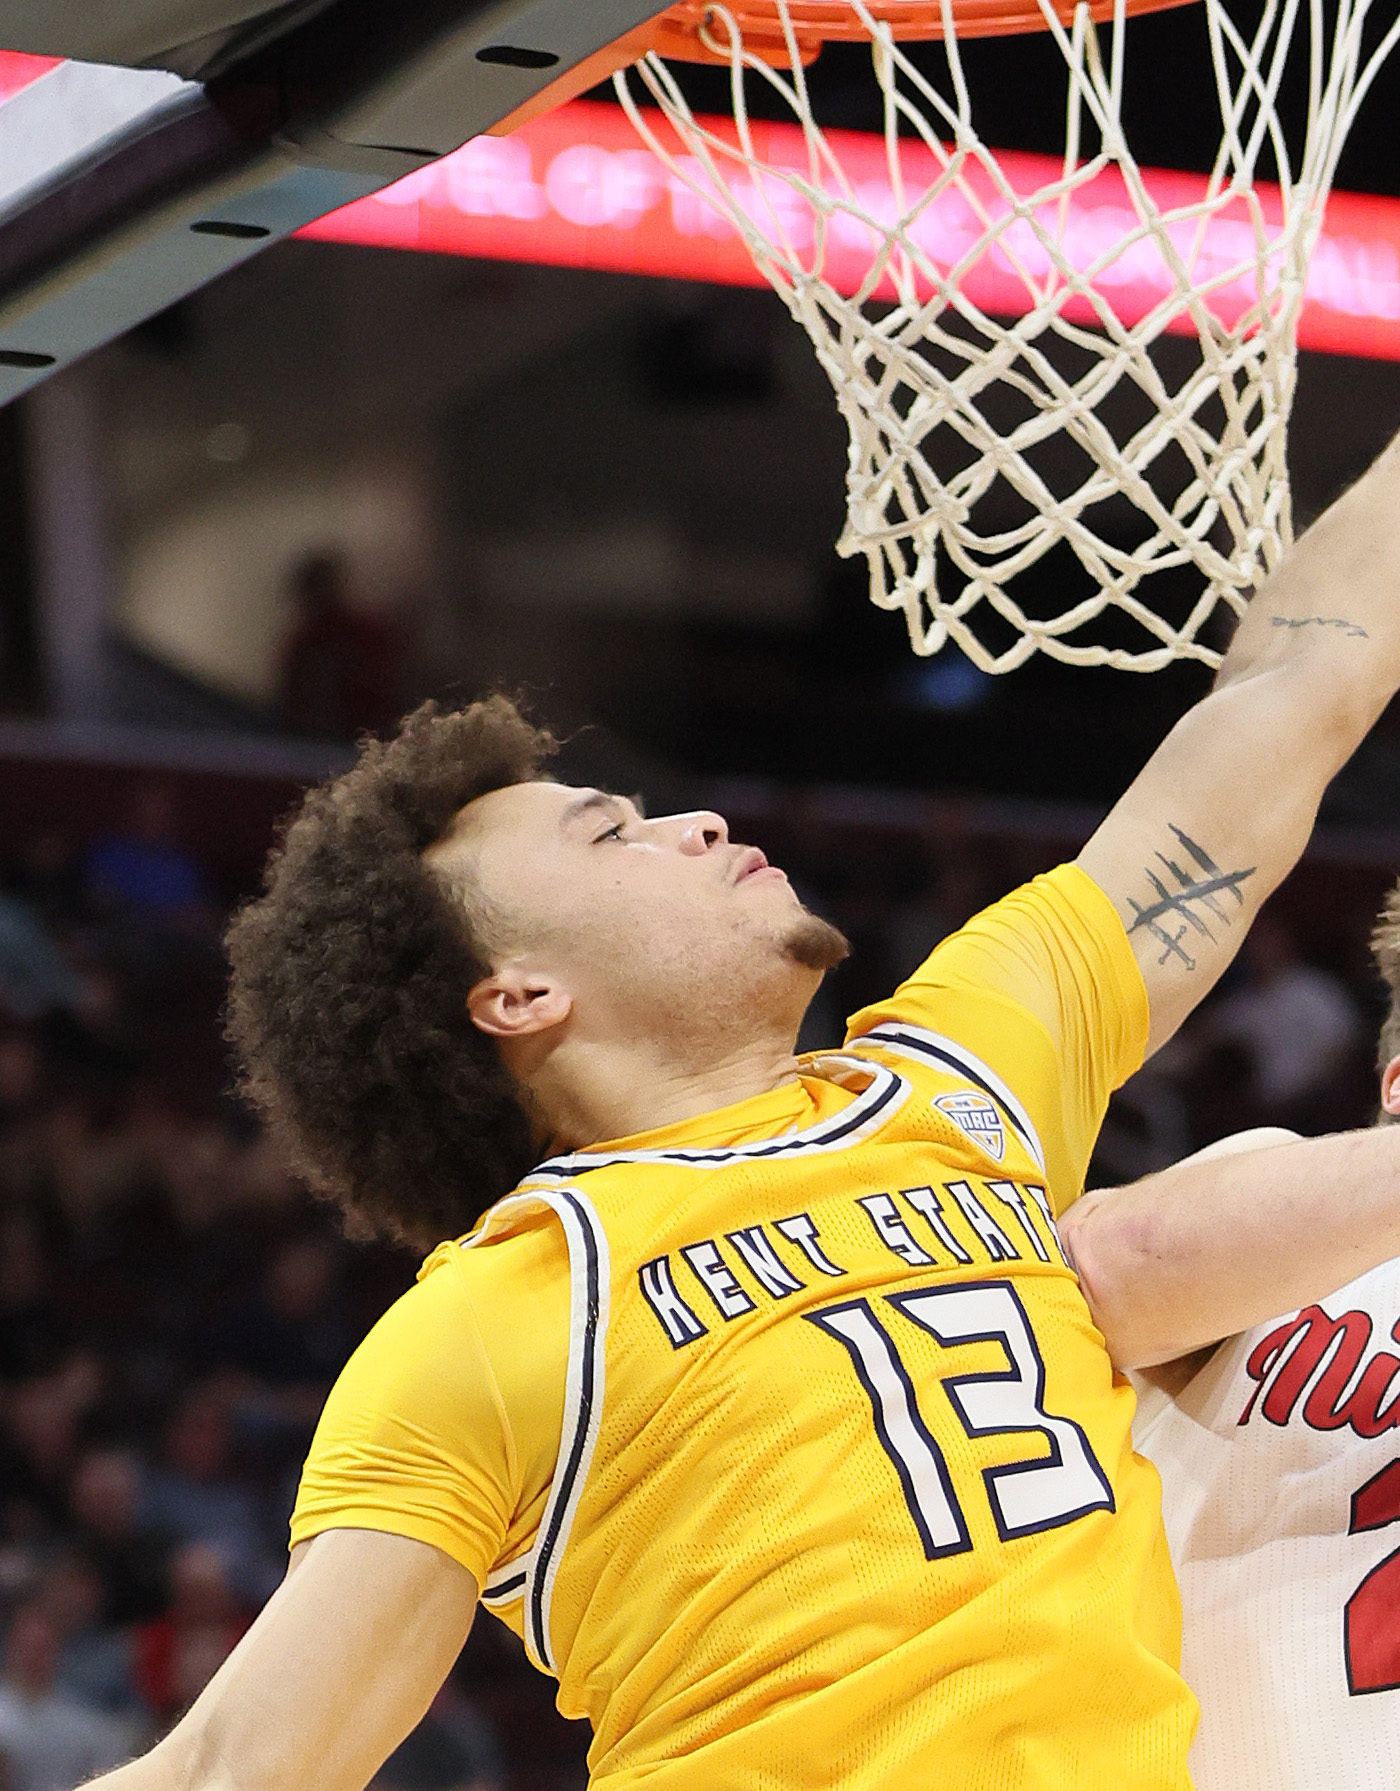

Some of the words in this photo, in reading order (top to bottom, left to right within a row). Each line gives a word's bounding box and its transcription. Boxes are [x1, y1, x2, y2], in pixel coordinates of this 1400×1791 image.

[948, 1110, 1002, 1131] MAC
[638, 1213, 848, 1350] KENT
[801, 1280, 1116, 1561] 13
